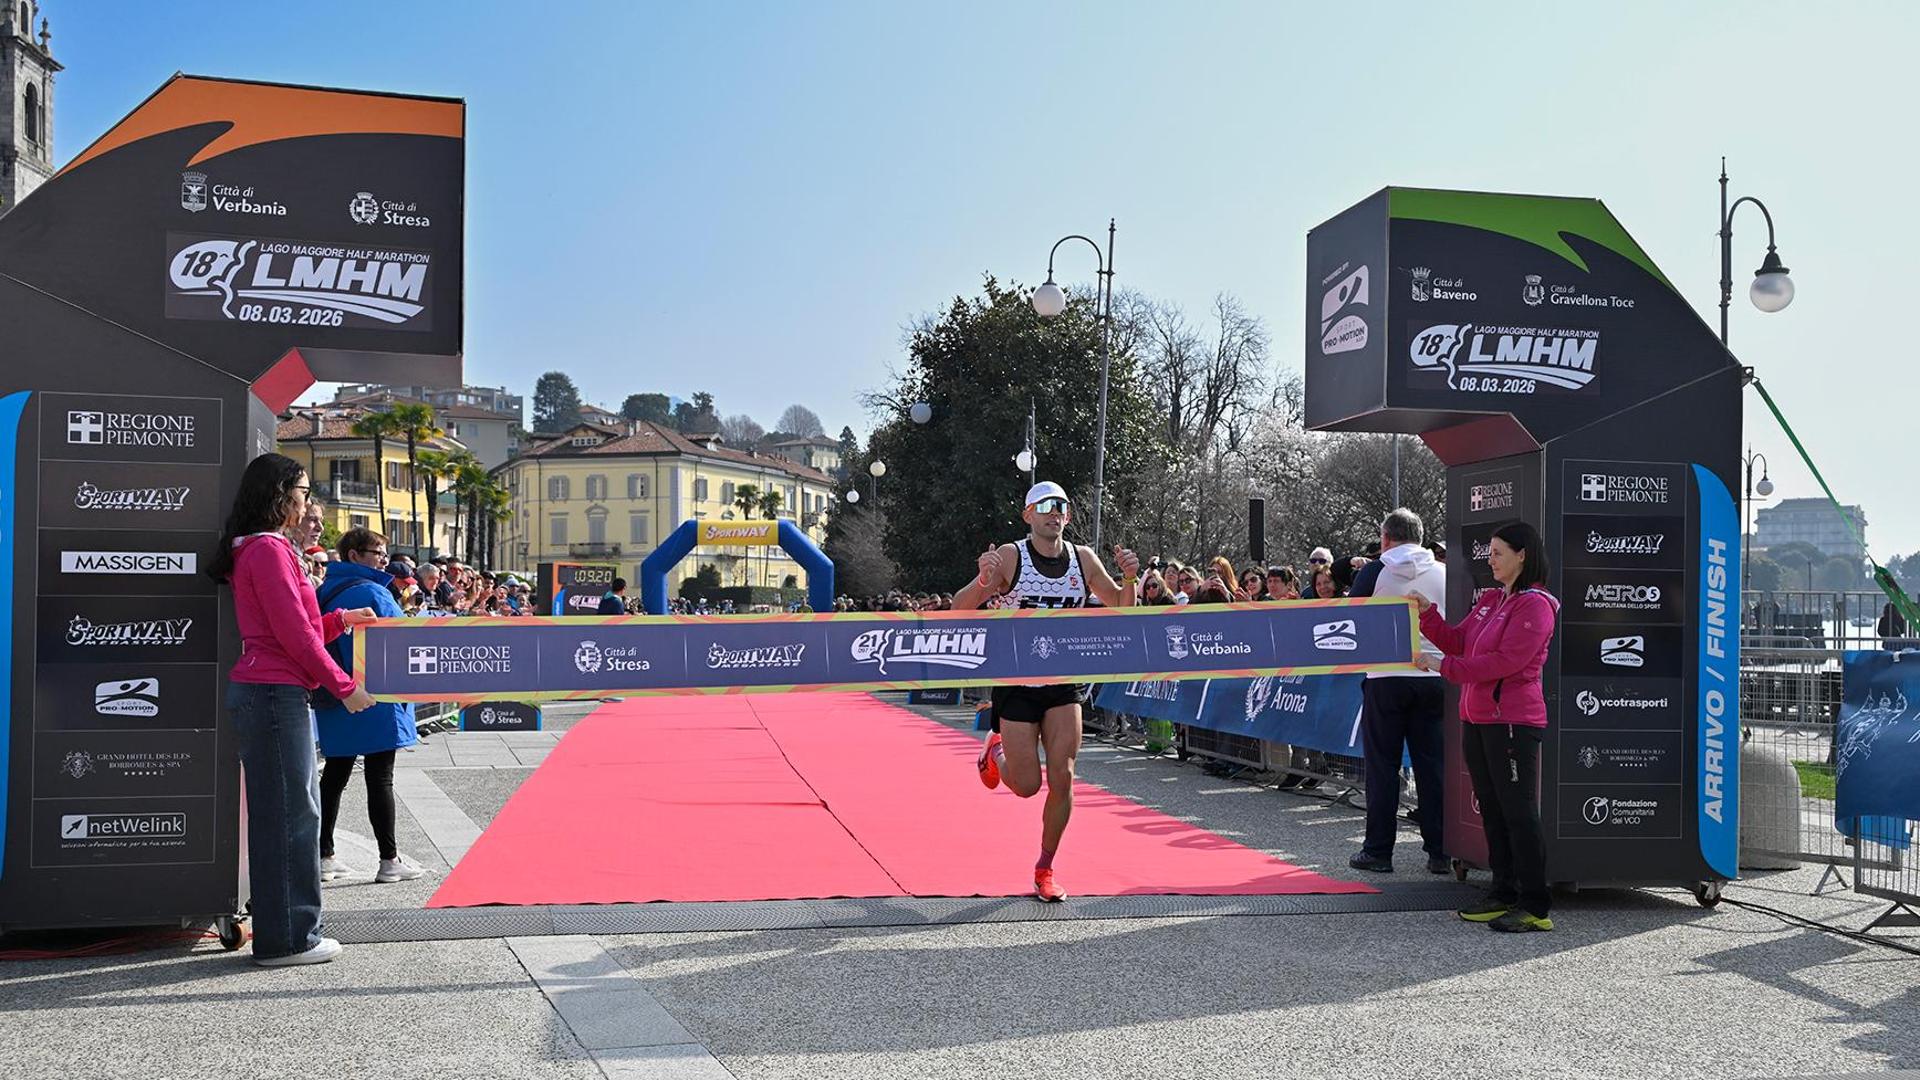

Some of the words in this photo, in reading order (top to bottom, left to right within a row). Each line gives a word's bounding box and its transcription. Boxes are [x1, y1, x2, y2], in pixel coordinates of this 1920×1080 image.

[212, 184, 240, 197] Città
[241, 185, 254, 198] di
[213, 197, 287, 216] Verbania
[381, 200, 405, 212] Città
[407, 201, 417, 212] di
[383, 212, 430, 228] Stresa
[260, 243, 290, 255] LAGO
[291, 245, 344, 259] MAGGIORE
[346, 248, 372, 261] HALF
[374, 252, 430, 265] MARATHON
[251, 257, 428, 302] LMHM
[1433, 277, 1453, 288] Città
[1455, 277, 1463, 288] di
[1433, 288, 1477, 301] Baveno
[1550, 284, 1566, 295] Città
[1567, 284, 1575, 295] di
[1550, 294, 1608, 308] Gravellona
[1609, 295, 1634, 308] Toce
[238, 304, 344, 327] 08.03.2026
[1474, 325, 1496, 334] LAGO
[1497, 326, 1537, 336] MAGGIORE
[1537, 328, 1556, 337] HALF
[1558, 330, 1599, 338] MARATHON
[1468, 336, 1598, 371] LMHM
[1460, 377, 1536, 394] 08.03.2026
[106, 413, 195, 431] REGIONE
[106, 430, 195, 447] PIEMONTE
[1482, 482, 1513, 496] REGIONE
[1608, 476, 1668, 490] REGIONE
[1482, 495, 1513, 509] PIEMONTE
[1607, 490, 1668, 503] PIEMONTE
[91, 503, 181, 511] MEGASTORE
[75, 555, 183, 571] MASSIGEN
[1707, 538, 1726, 659] FINISH
[858, 634, 877, 648] 21
[893, 633, 987, 656] LMHM
[1190, 632, 1213, 643] Città
[1214, 632, 1223, 641] di
[440, 646, 510, 660] REGIONE
[604, 647, 626, 657] Città
[627, 647, 637, 657] di
[1191, 643, 1251, 656] Verbania
[440, 660, 511, 674] PIEMONTE
[606, 657, 650, 671] Stresa
[1270, 686, 1307, 713] Arona
[1601, 698, 1668, 709] vcotrasporti
[498, 715, 522, 724] Stresa
[1704, 689, 1725, 824] ARRIVO
[1612, 800, 1658, 808] Fondazione
[1612, 808, 1655, 816] Comunitaria
[90, 816, 182, 833] netWelink
[1612, 817, 1624, 825] del
[1624, 817, 1641, 825] VCO
